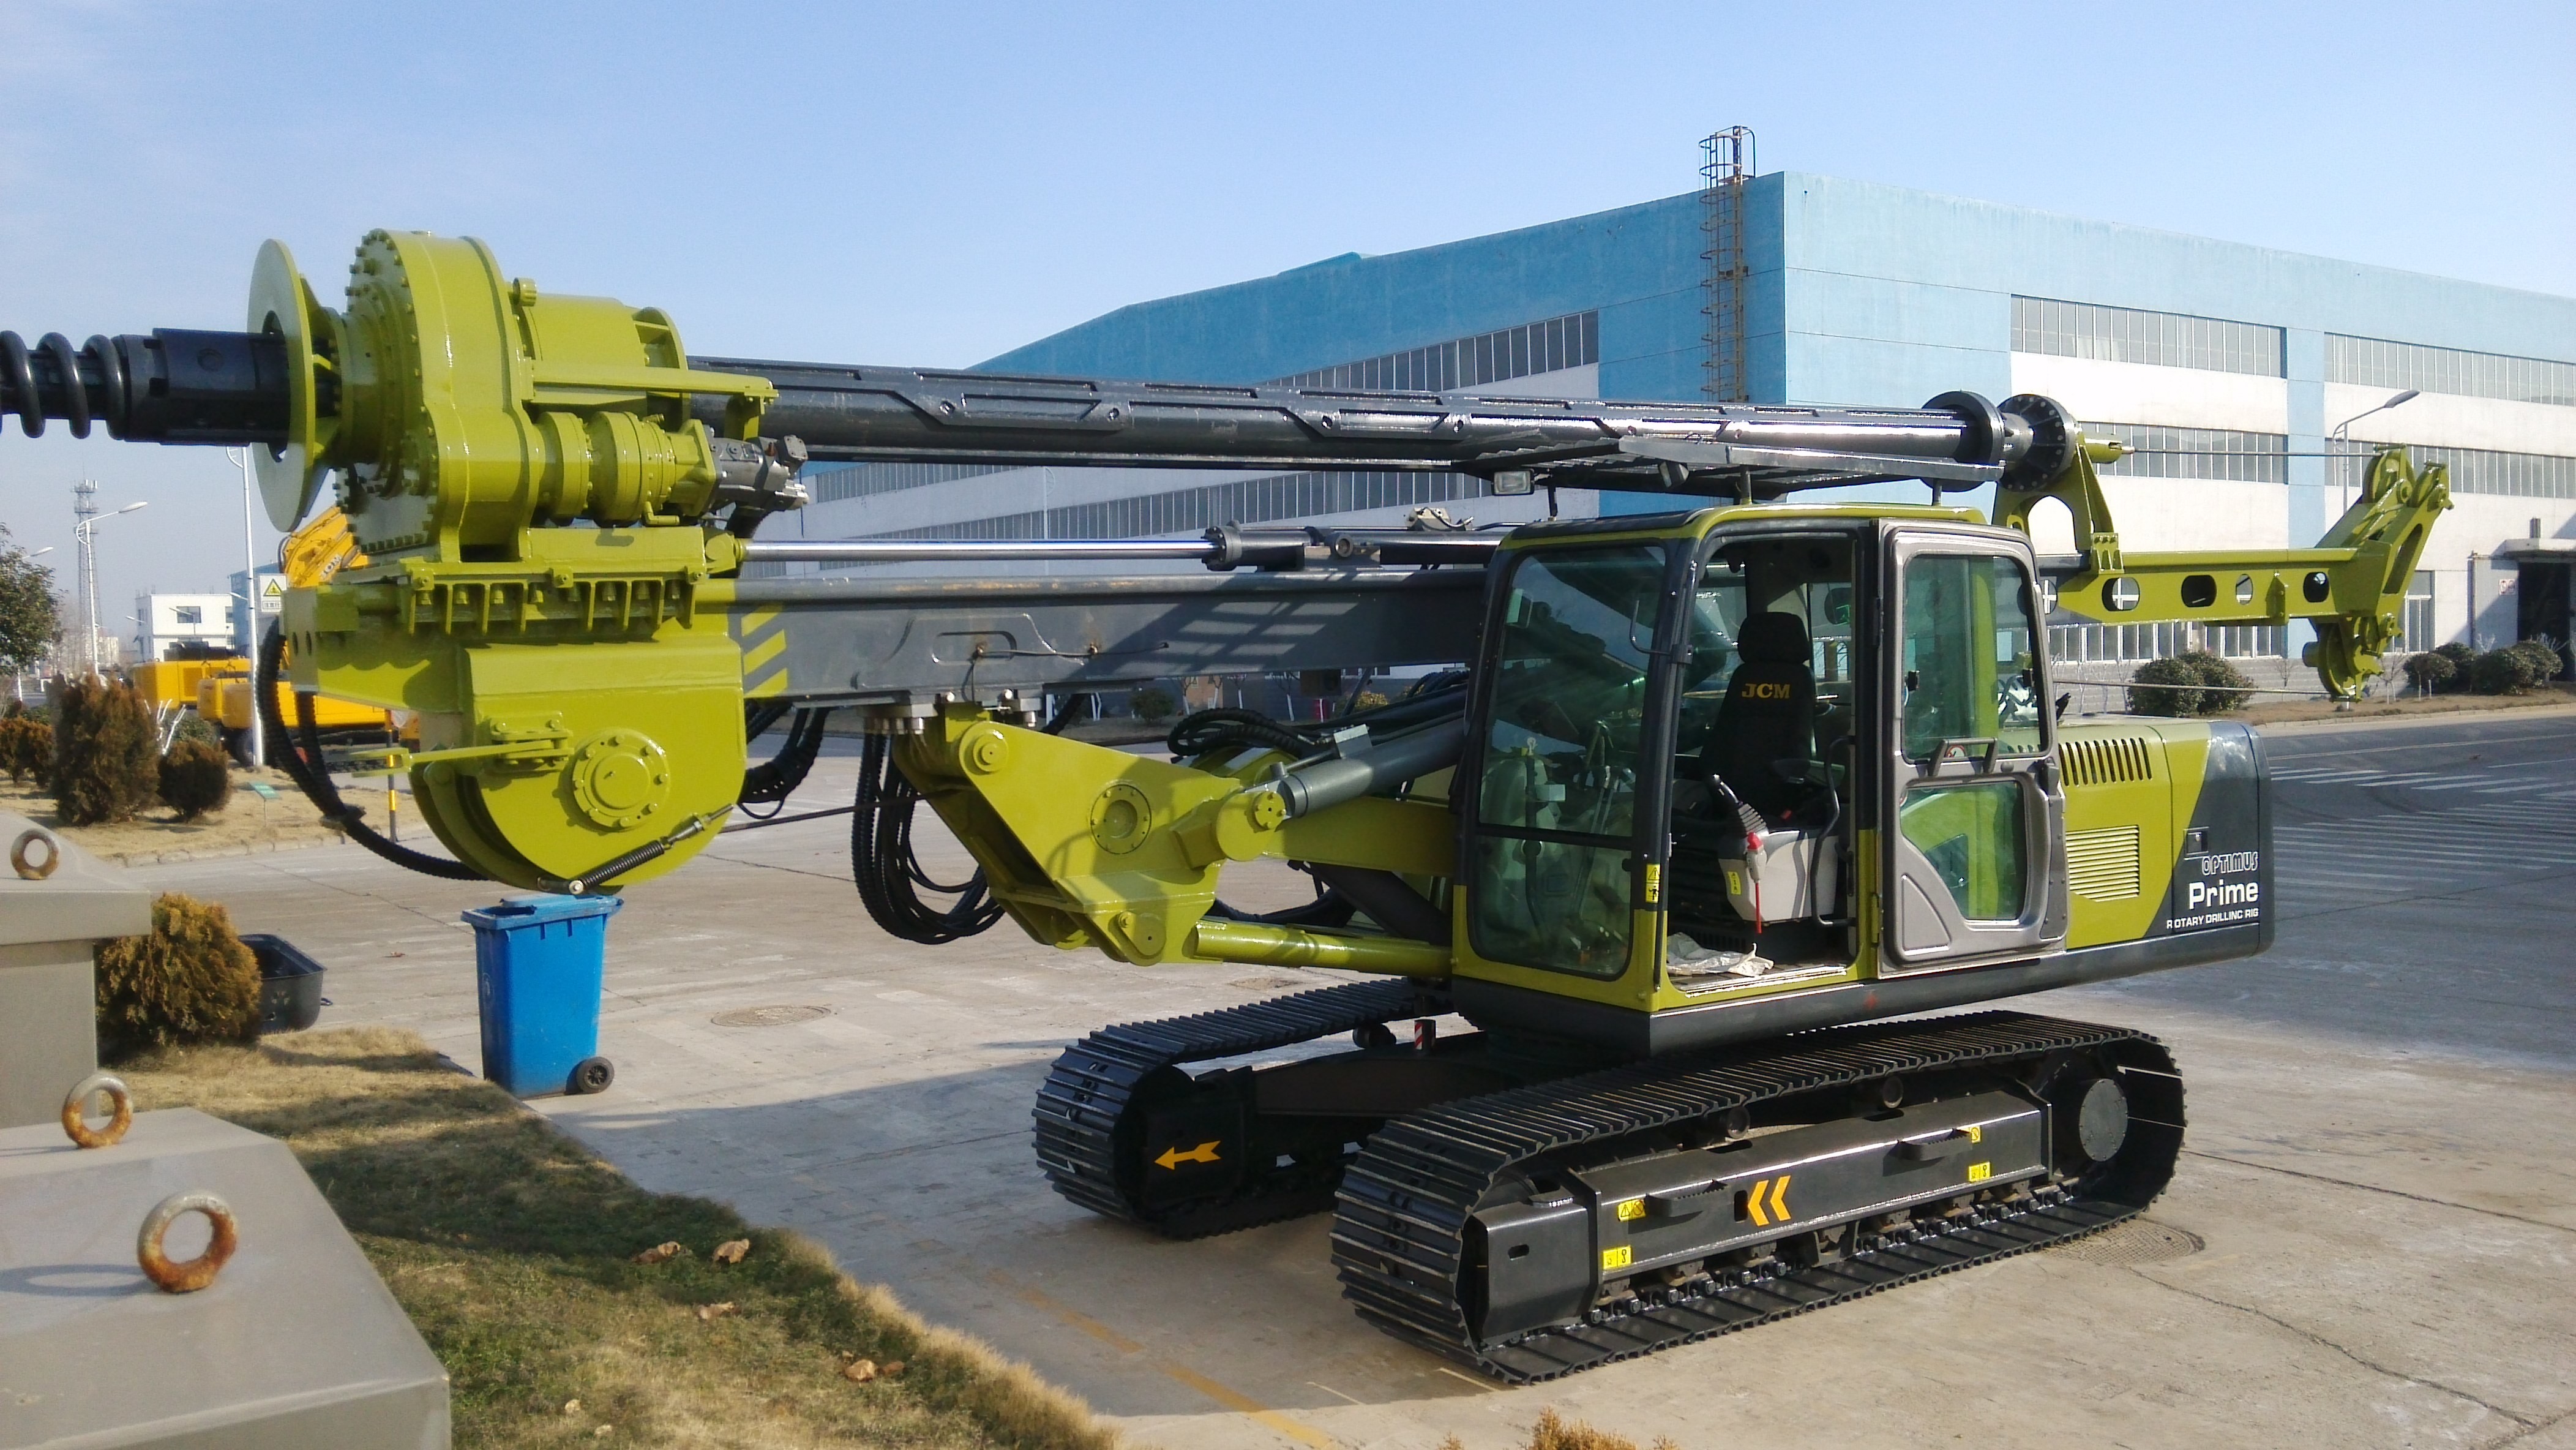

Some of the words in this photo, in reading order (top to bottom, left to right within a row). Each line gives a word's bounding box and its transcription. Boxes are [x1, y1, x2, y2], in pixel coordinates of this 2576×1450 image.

[1742, 683, 1791, 699] JCM
[2202, 851, 2258, 876] OPTIMUS
[2188, 879, 2259, 910] Prime
[2166, 915, 2204, 930] ROTARY
[2206, 909, 2243, 924] DRILLING
[2245, 907, 2259, 918] RIG
